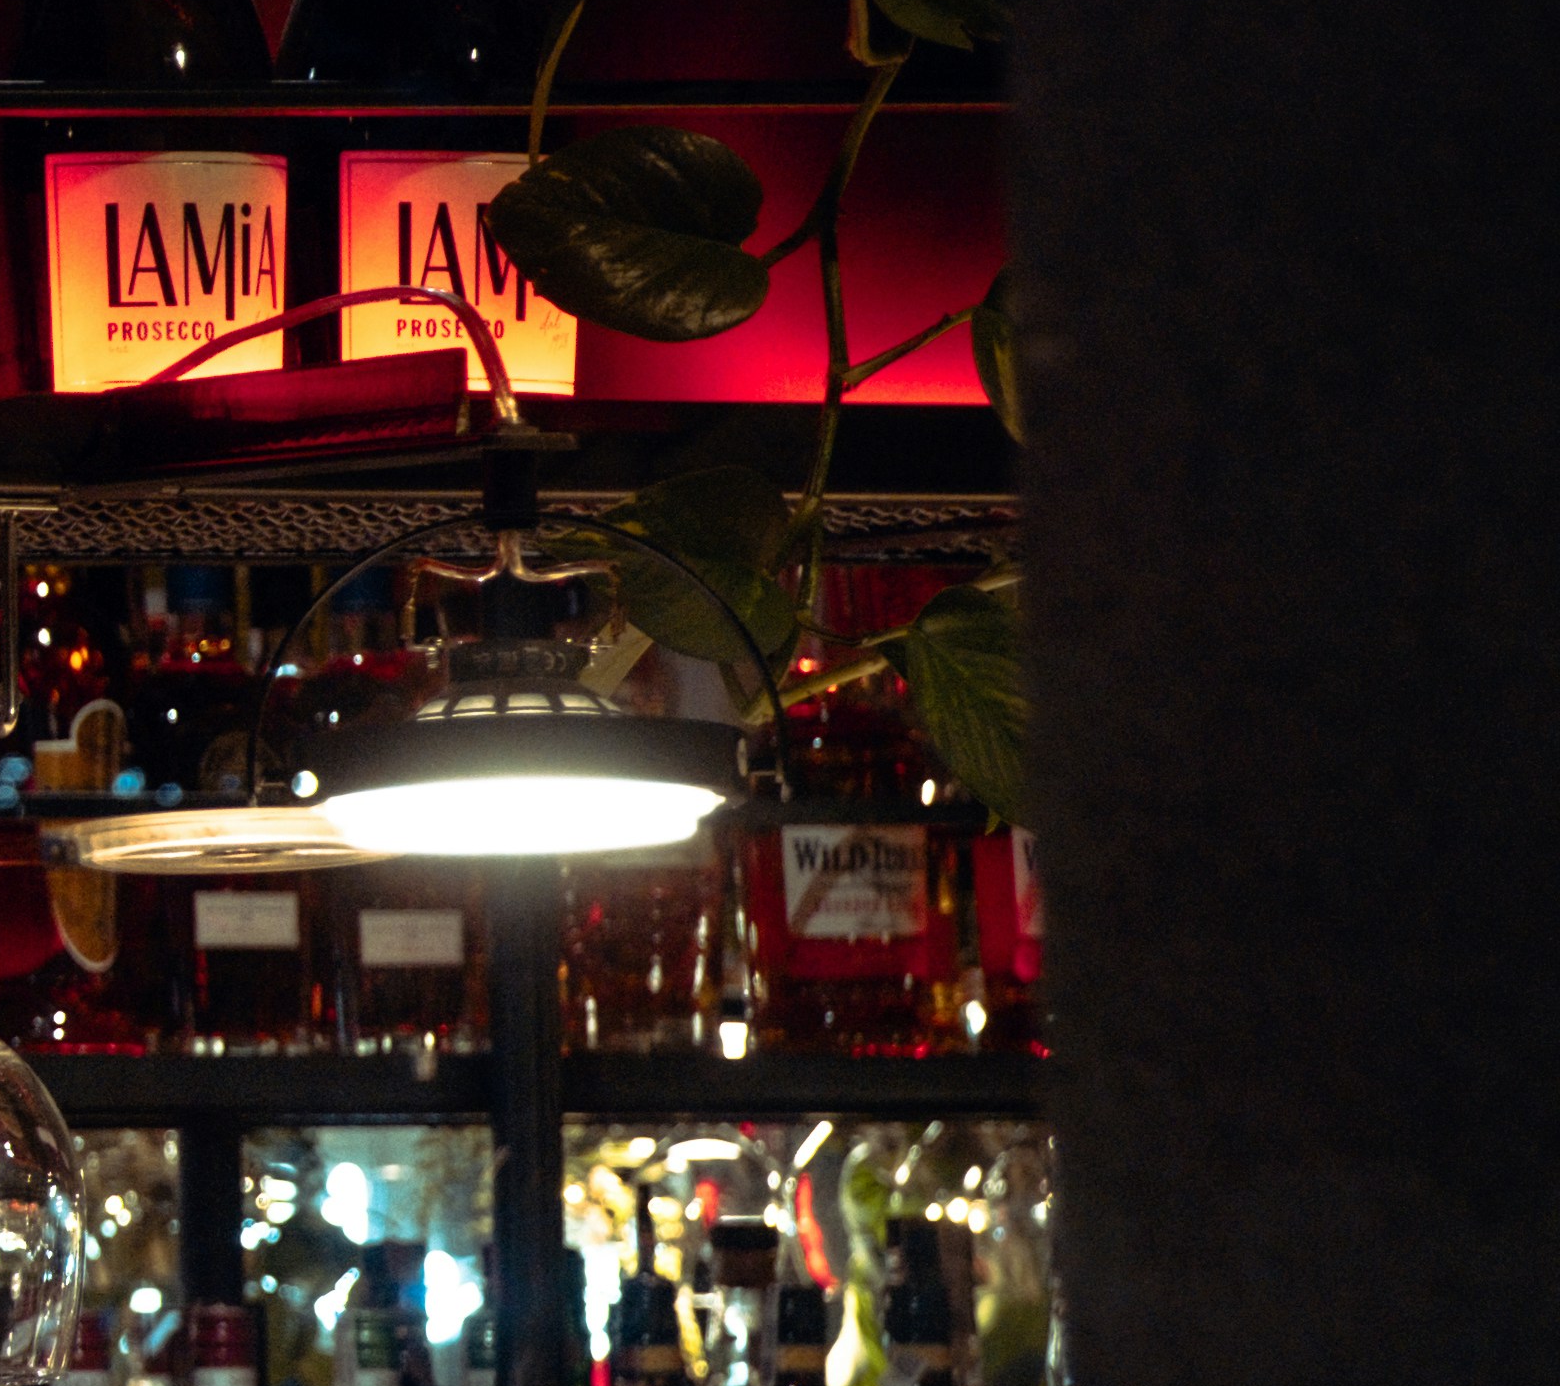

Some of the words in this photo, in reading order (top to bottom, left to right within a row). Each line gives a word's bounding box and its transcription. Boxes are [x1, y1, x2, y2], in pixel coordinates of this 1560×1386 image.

[399, 201, 538, 321] LAM
[107, 321, 215, 341] PROSECCO
[397, 319, 505, 339] PROSEO
